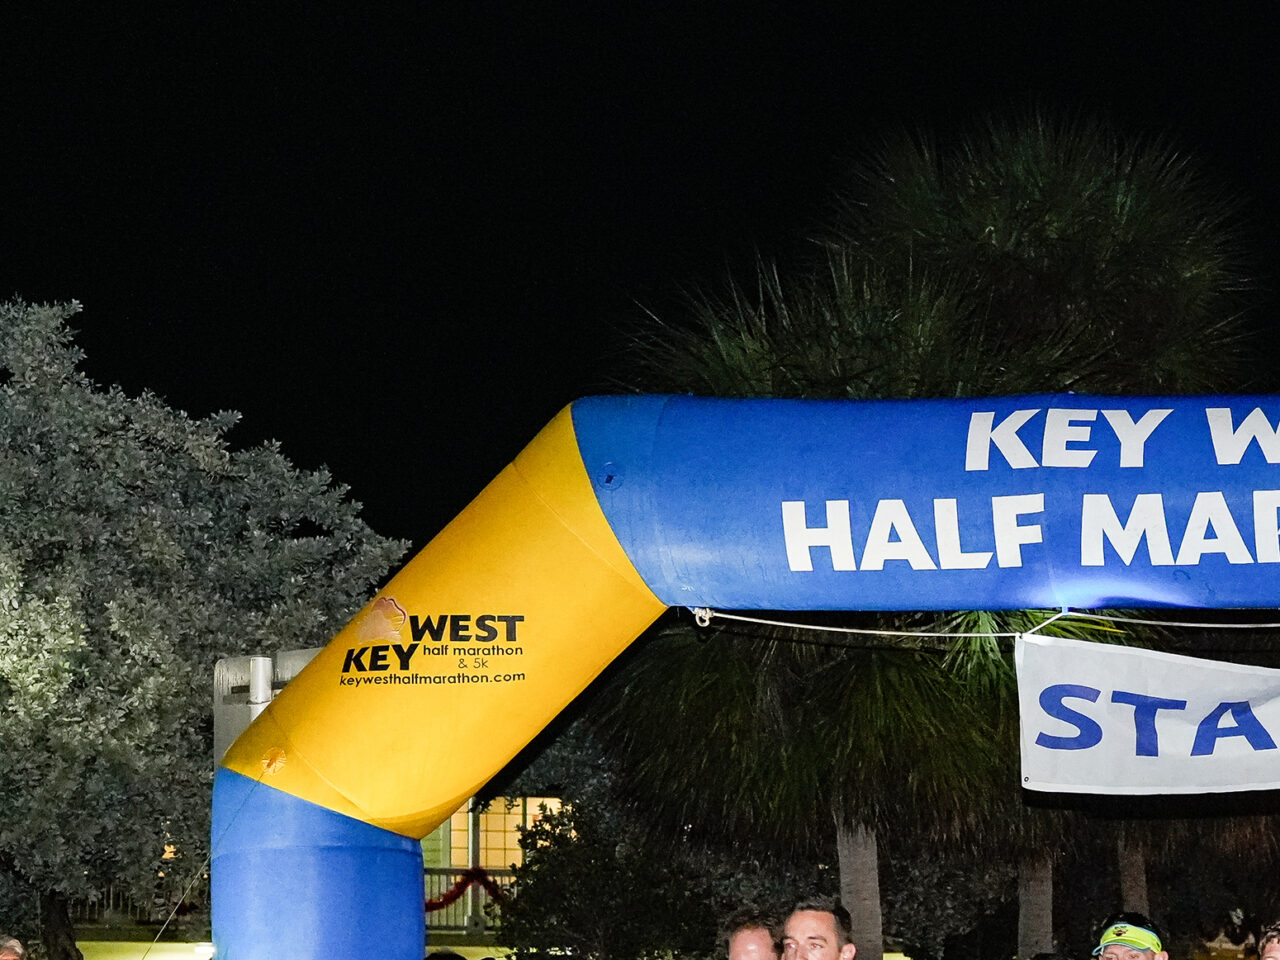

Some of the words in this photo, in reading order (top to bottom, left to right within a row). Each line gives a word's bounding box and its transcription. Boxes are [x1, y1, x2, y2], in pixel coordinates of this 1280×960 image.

[965, 409, 1174, 471] KEY
[782, 493, 1044, 571] HALF
[409, 615, 524, 641] WEST
[342, 643, 419, 673] KEY
[423, 645, 449, 656] half
[453, 645, 523, 656] marathon
[458, 658, 468, 669] &
[473, 657, 488, 669] 5k
[340, 672, 525, 687] keywesthalfmarathon.com
